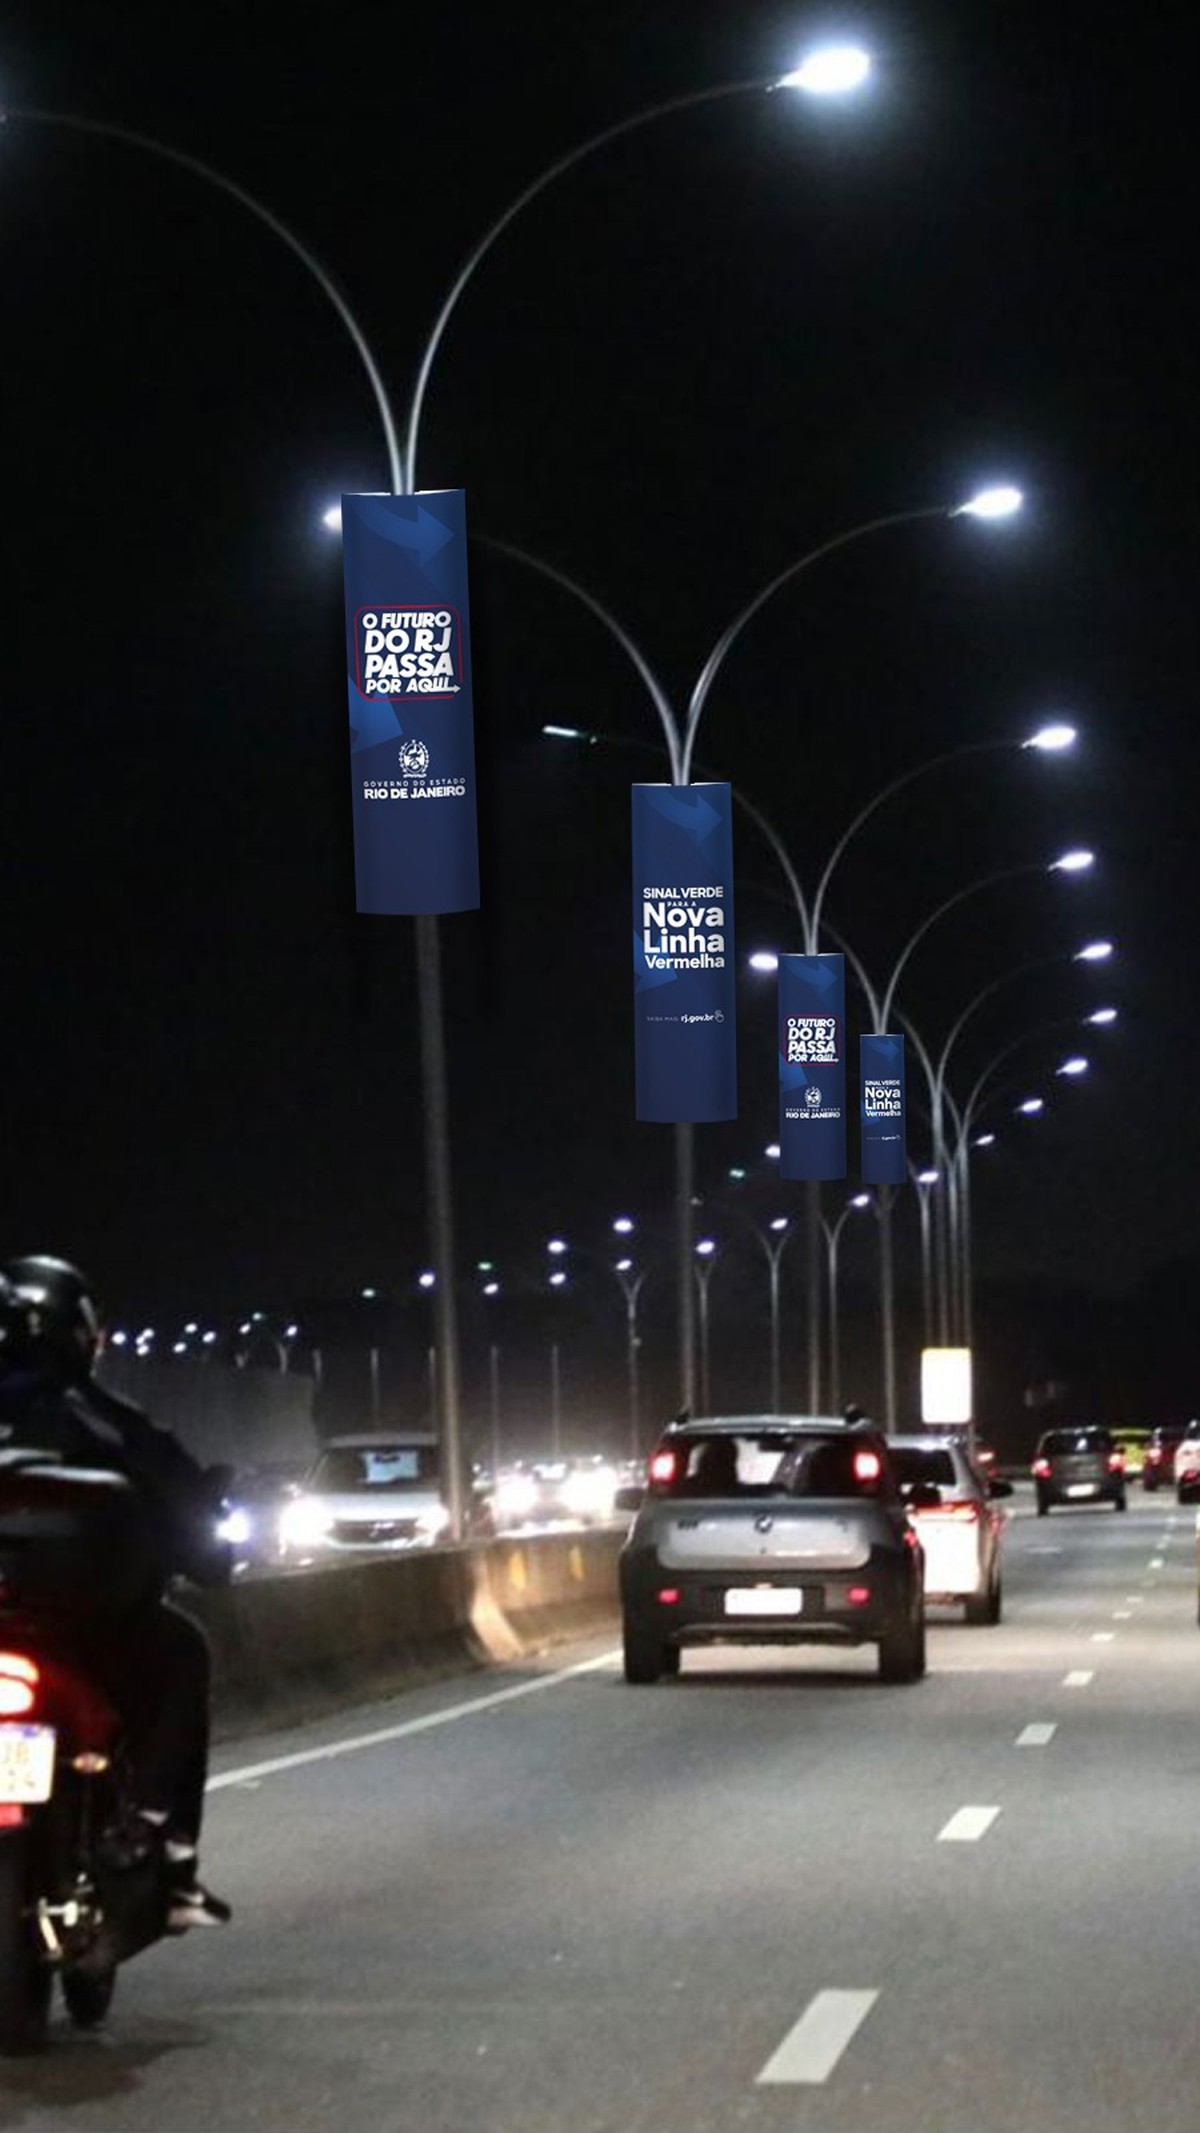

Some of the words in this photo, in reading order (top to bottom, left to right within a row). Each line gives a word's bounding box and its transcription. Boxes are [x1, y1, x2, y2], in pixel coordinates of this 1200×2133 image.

[362, 613, 378, 629] O
[381, 611, 452, 629] FUTURO
[364, 629, 410, 653] DO
[414, 627, 452, 653] RJ
[365, 652, 454, 679] PASSA
[365, 679, 402, 694] POR
[406, 677, 454, 693] AQUI
[363, 780, 409, 788] GOVERNO
[430, 778, 466, 786] ESTADO
[364, 788, 389, 799] RIO
[390, 788, 409, 799] DE
[410, 785, 466, 799] JANEIRO
[643, 887, 681, 899] SINAL
[681, 886, 724, 899] VERDE
[643, 902, 725, 928] Nova
[643, 928, 725, 953] Linha
[644, 954, 725, 969] Vermelha
[787, 1018, 796, 1027] O
[797, 1018, 836, 1028] FUTURO
[788, 1027, 813, 1040] DO
[815, 1027, 836, 1040] RJ
[788, 1040, 836, 1054] PASSA
[788, 1054, 808, 1062] POR
[865, 1086, 901, 1098] Nova
[865, 1098, 901, 1110] Linha
[810, 1111, 841, 1119] JANEIRO
